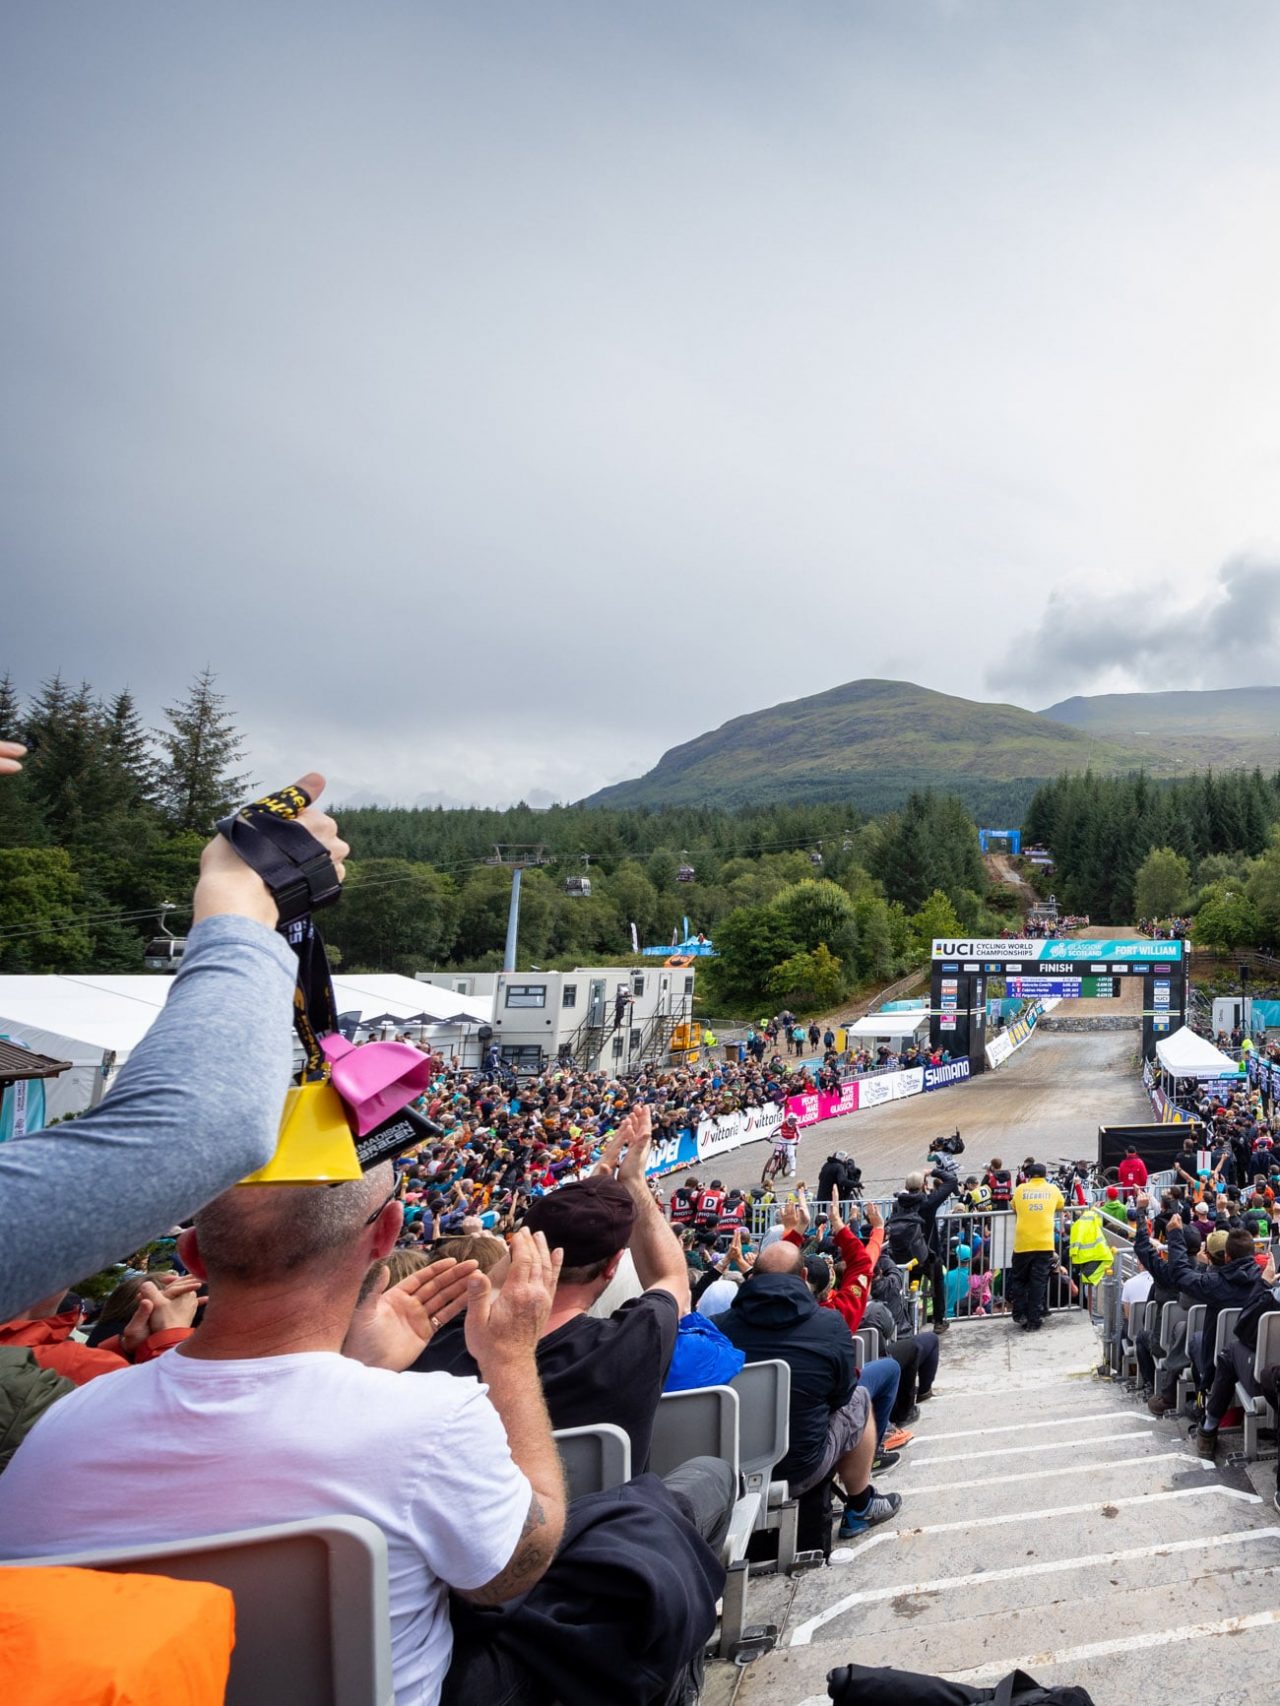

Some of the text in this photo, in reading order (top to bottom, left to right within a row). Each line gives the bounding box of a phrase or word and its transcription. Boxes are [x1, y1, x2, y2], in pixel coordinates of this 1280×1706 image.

[943, 943, 974, 956] UCI
[1115, 946, 1177, 955] FORT WILLIAM
[1039, 963, 1073, 973] FINISH
[925, 1060, 970, 1087] SHIMANO
[754, 1111, 783, 1129] vittoria
[357, 1120, 410, 1150] MADISON
[710, 1124, 739, 1143] vittoria
[643, 1133, 683, 1170] APEI
[980, 1188, 988, 1198] D
[1022, 1192, 1052, 1200] SECURITY
[678, 1198, 686, 1208] D
[704, 1198, 715, 1208] D
[1029, 1203, 1044, 1211] 253
